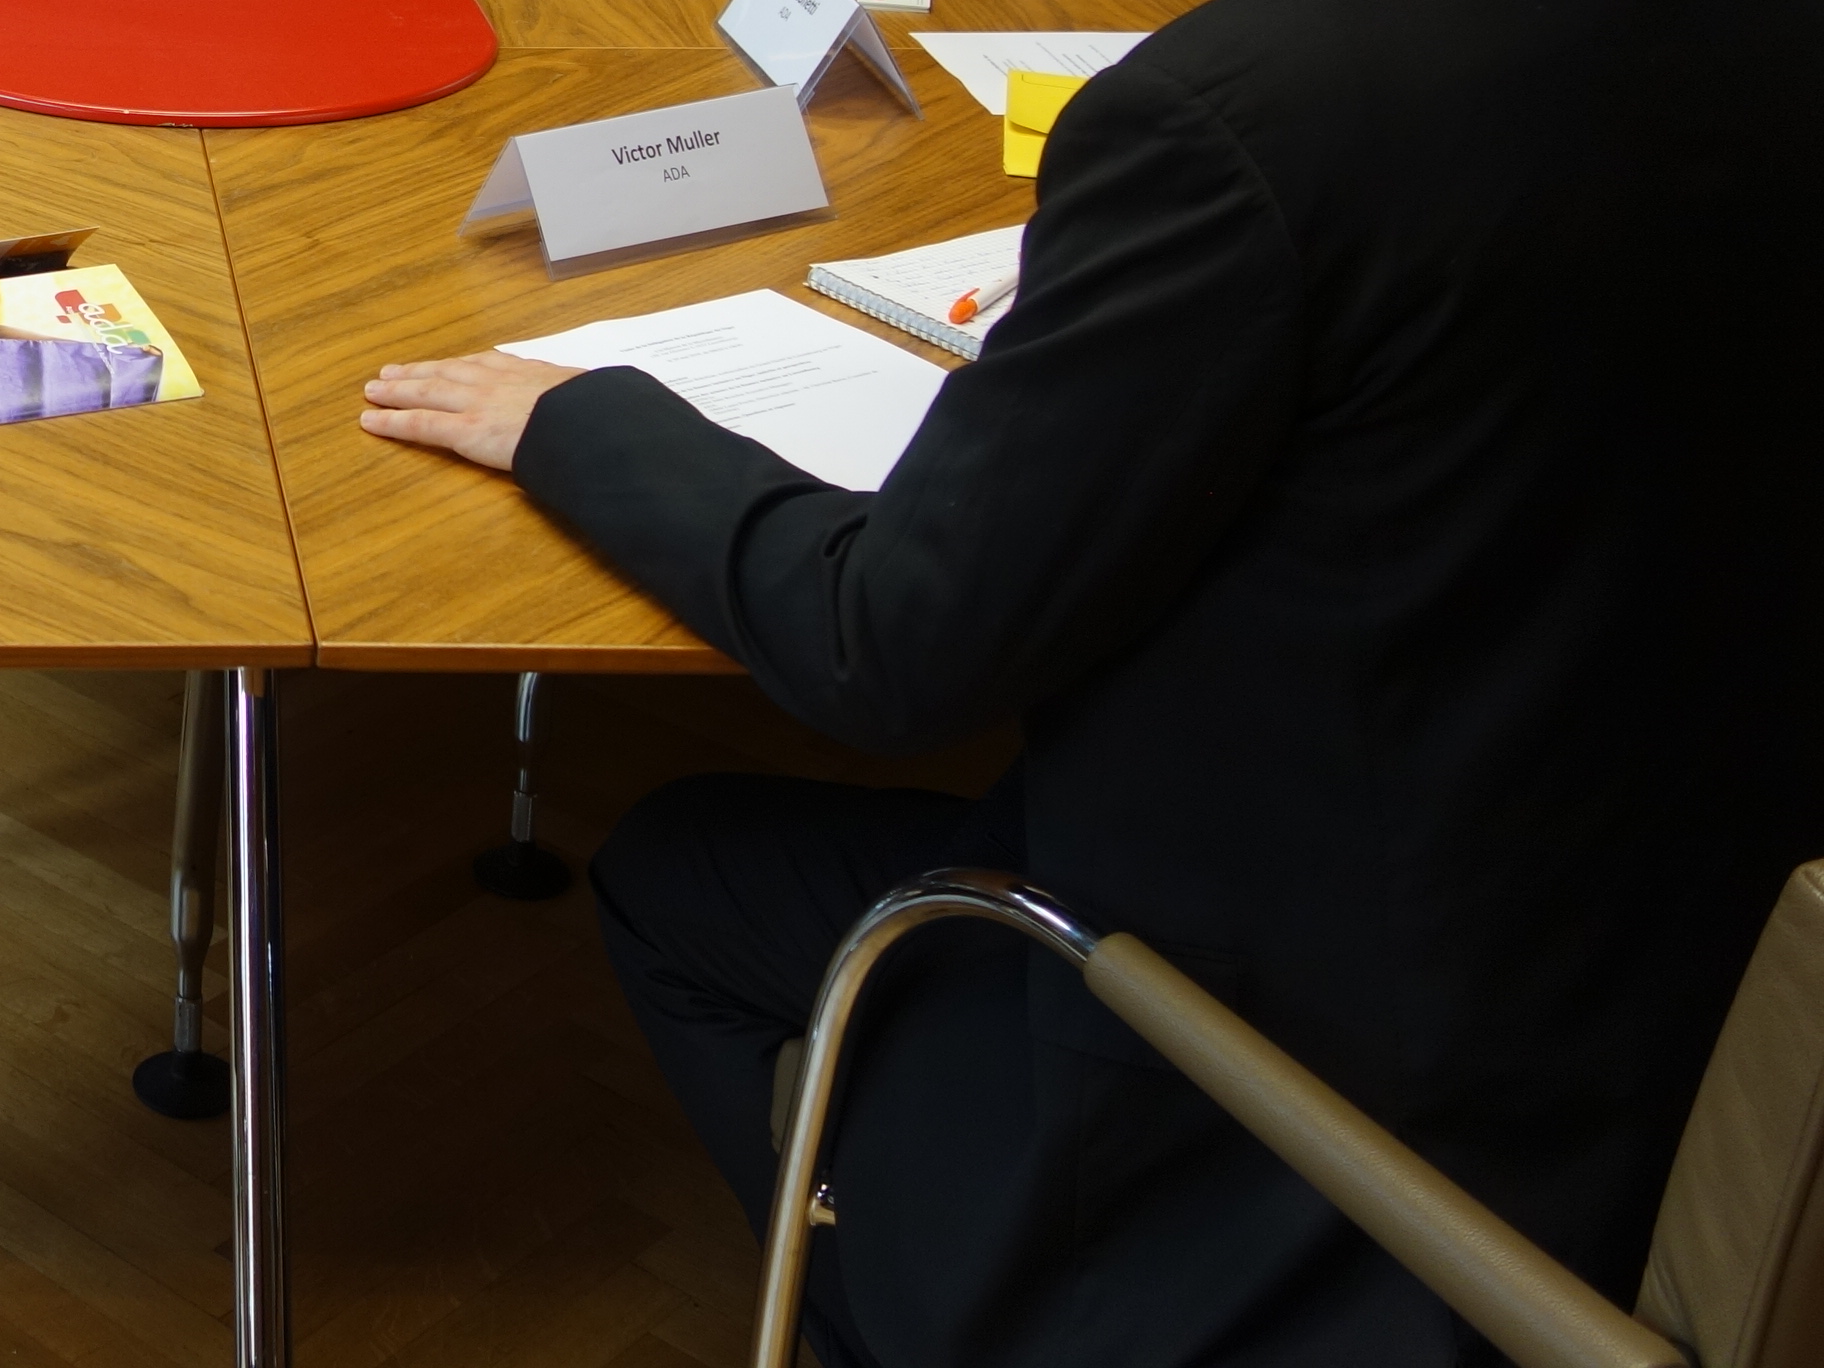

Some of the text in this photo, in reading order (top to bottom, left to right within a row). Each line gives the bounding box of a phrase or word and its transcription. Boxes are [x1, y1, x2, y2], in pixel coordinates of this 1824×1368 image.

[611, 130, 721, 165] Victor Muller
[662, 165, 691, 183] ADA
[78, 303, 134, 354] ada
